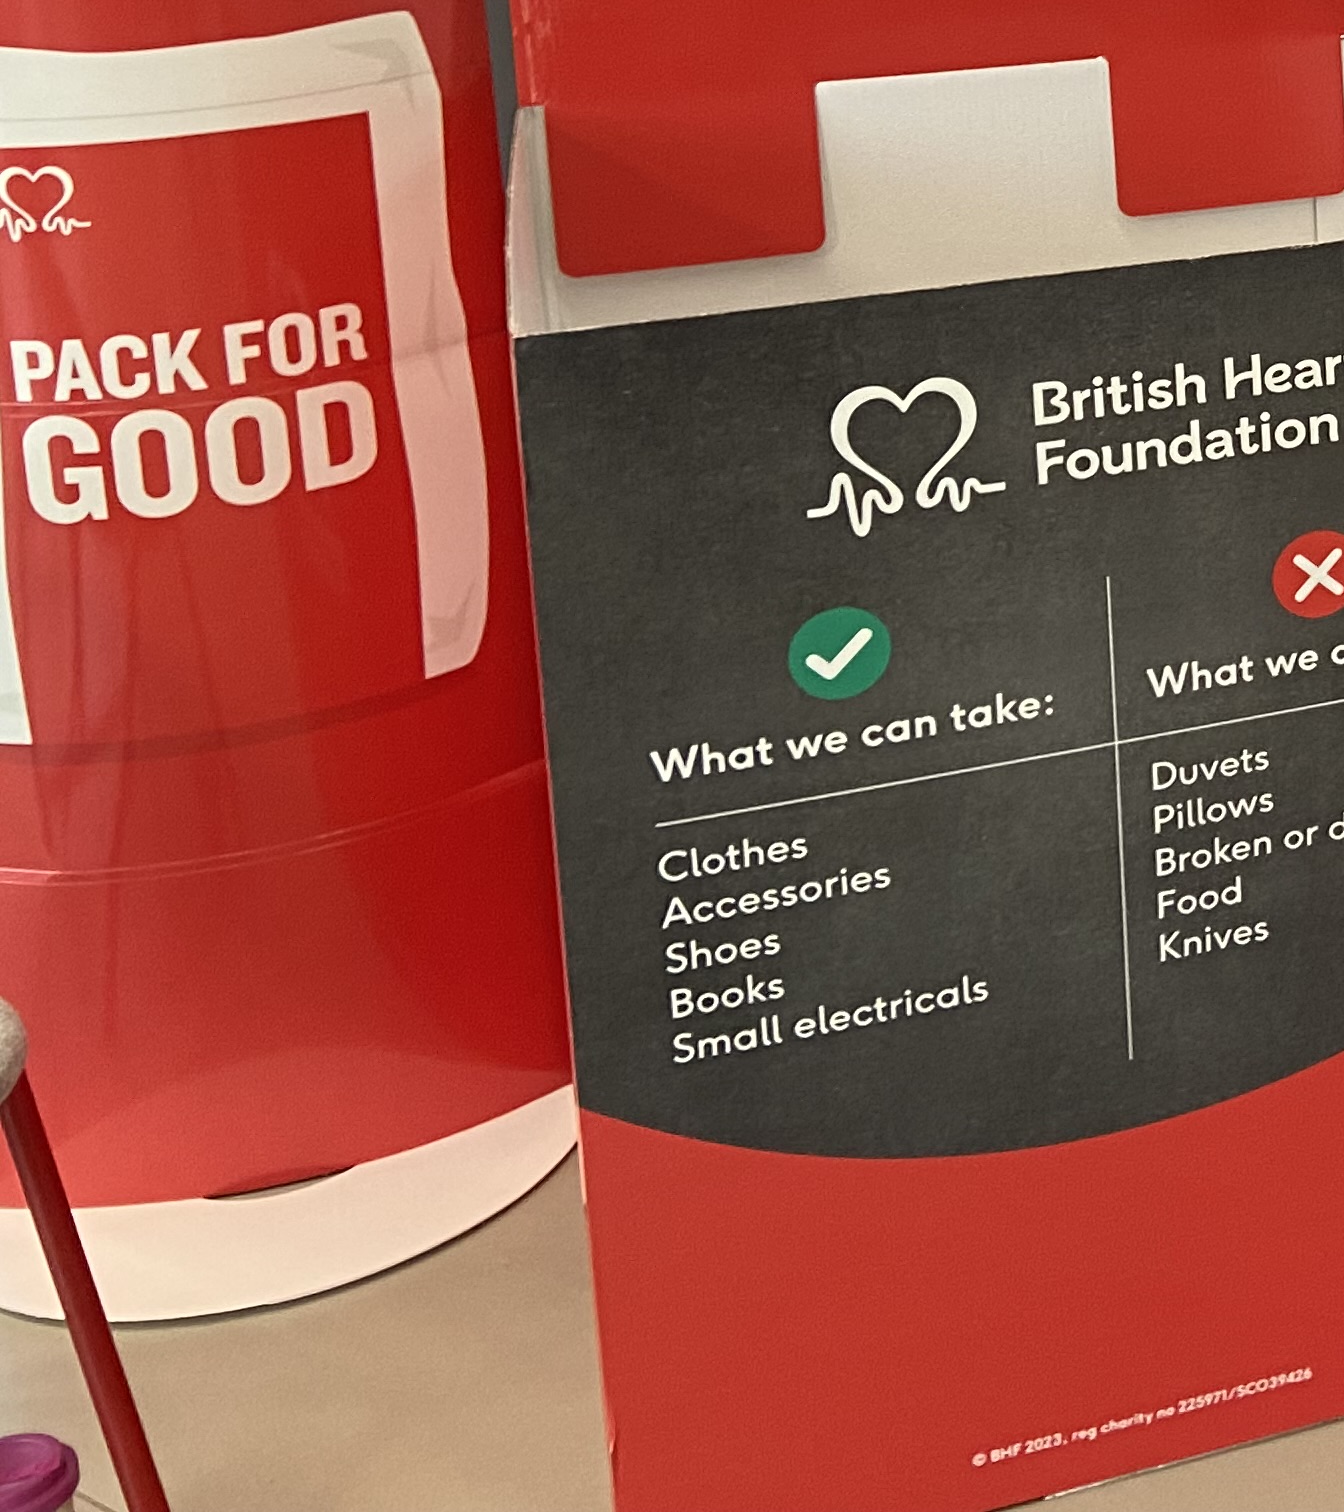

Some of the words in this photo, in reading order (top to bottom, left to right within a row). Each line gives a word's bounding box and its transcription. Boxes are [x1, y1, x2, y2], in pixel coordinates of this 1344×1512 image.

[10, 328, 209, 402] PACK
[223, 303, 368, 385] FOR
[1032, 367, 1207, 428] British
[22, 380, 379, 525] GOOD
[1035, 411, 1340, 485] Foundation
[1146, 655, 1254, 699] What
[1264, 645, 1320, 675] we
[650, 733, 774, 783] What
[787, 729, 848, 759] we
[861, 711, 939, 749] can
[950, 692, 1055, 733] take:
[1151, 745, 1270, 790] Duvets
[1152, 786, 1275, 835] Pillows
[658, 833, 809, 884] Clothes
[1154, 829, 1274, 877] Broken
[1283, 822, 1319, 850] or
[660, 862, 892, 930] Accessories
[1156, 878, 1243, 920] Food
[664, 927, 782, 976] Shoes
[1158, 915, 1270, 962] Knives
[670, 971, 786, 1020] Books
[671, 1015, 783, 1065] Small
[794, 974, 990, 1041] electricals
[990, 1442, 1023, 1464] BHF
[1070, 1426, 1098, 1444] reg
[1099, 1410, 1154, 1435] charity
[1156, 1405, 1175, 1419] no
